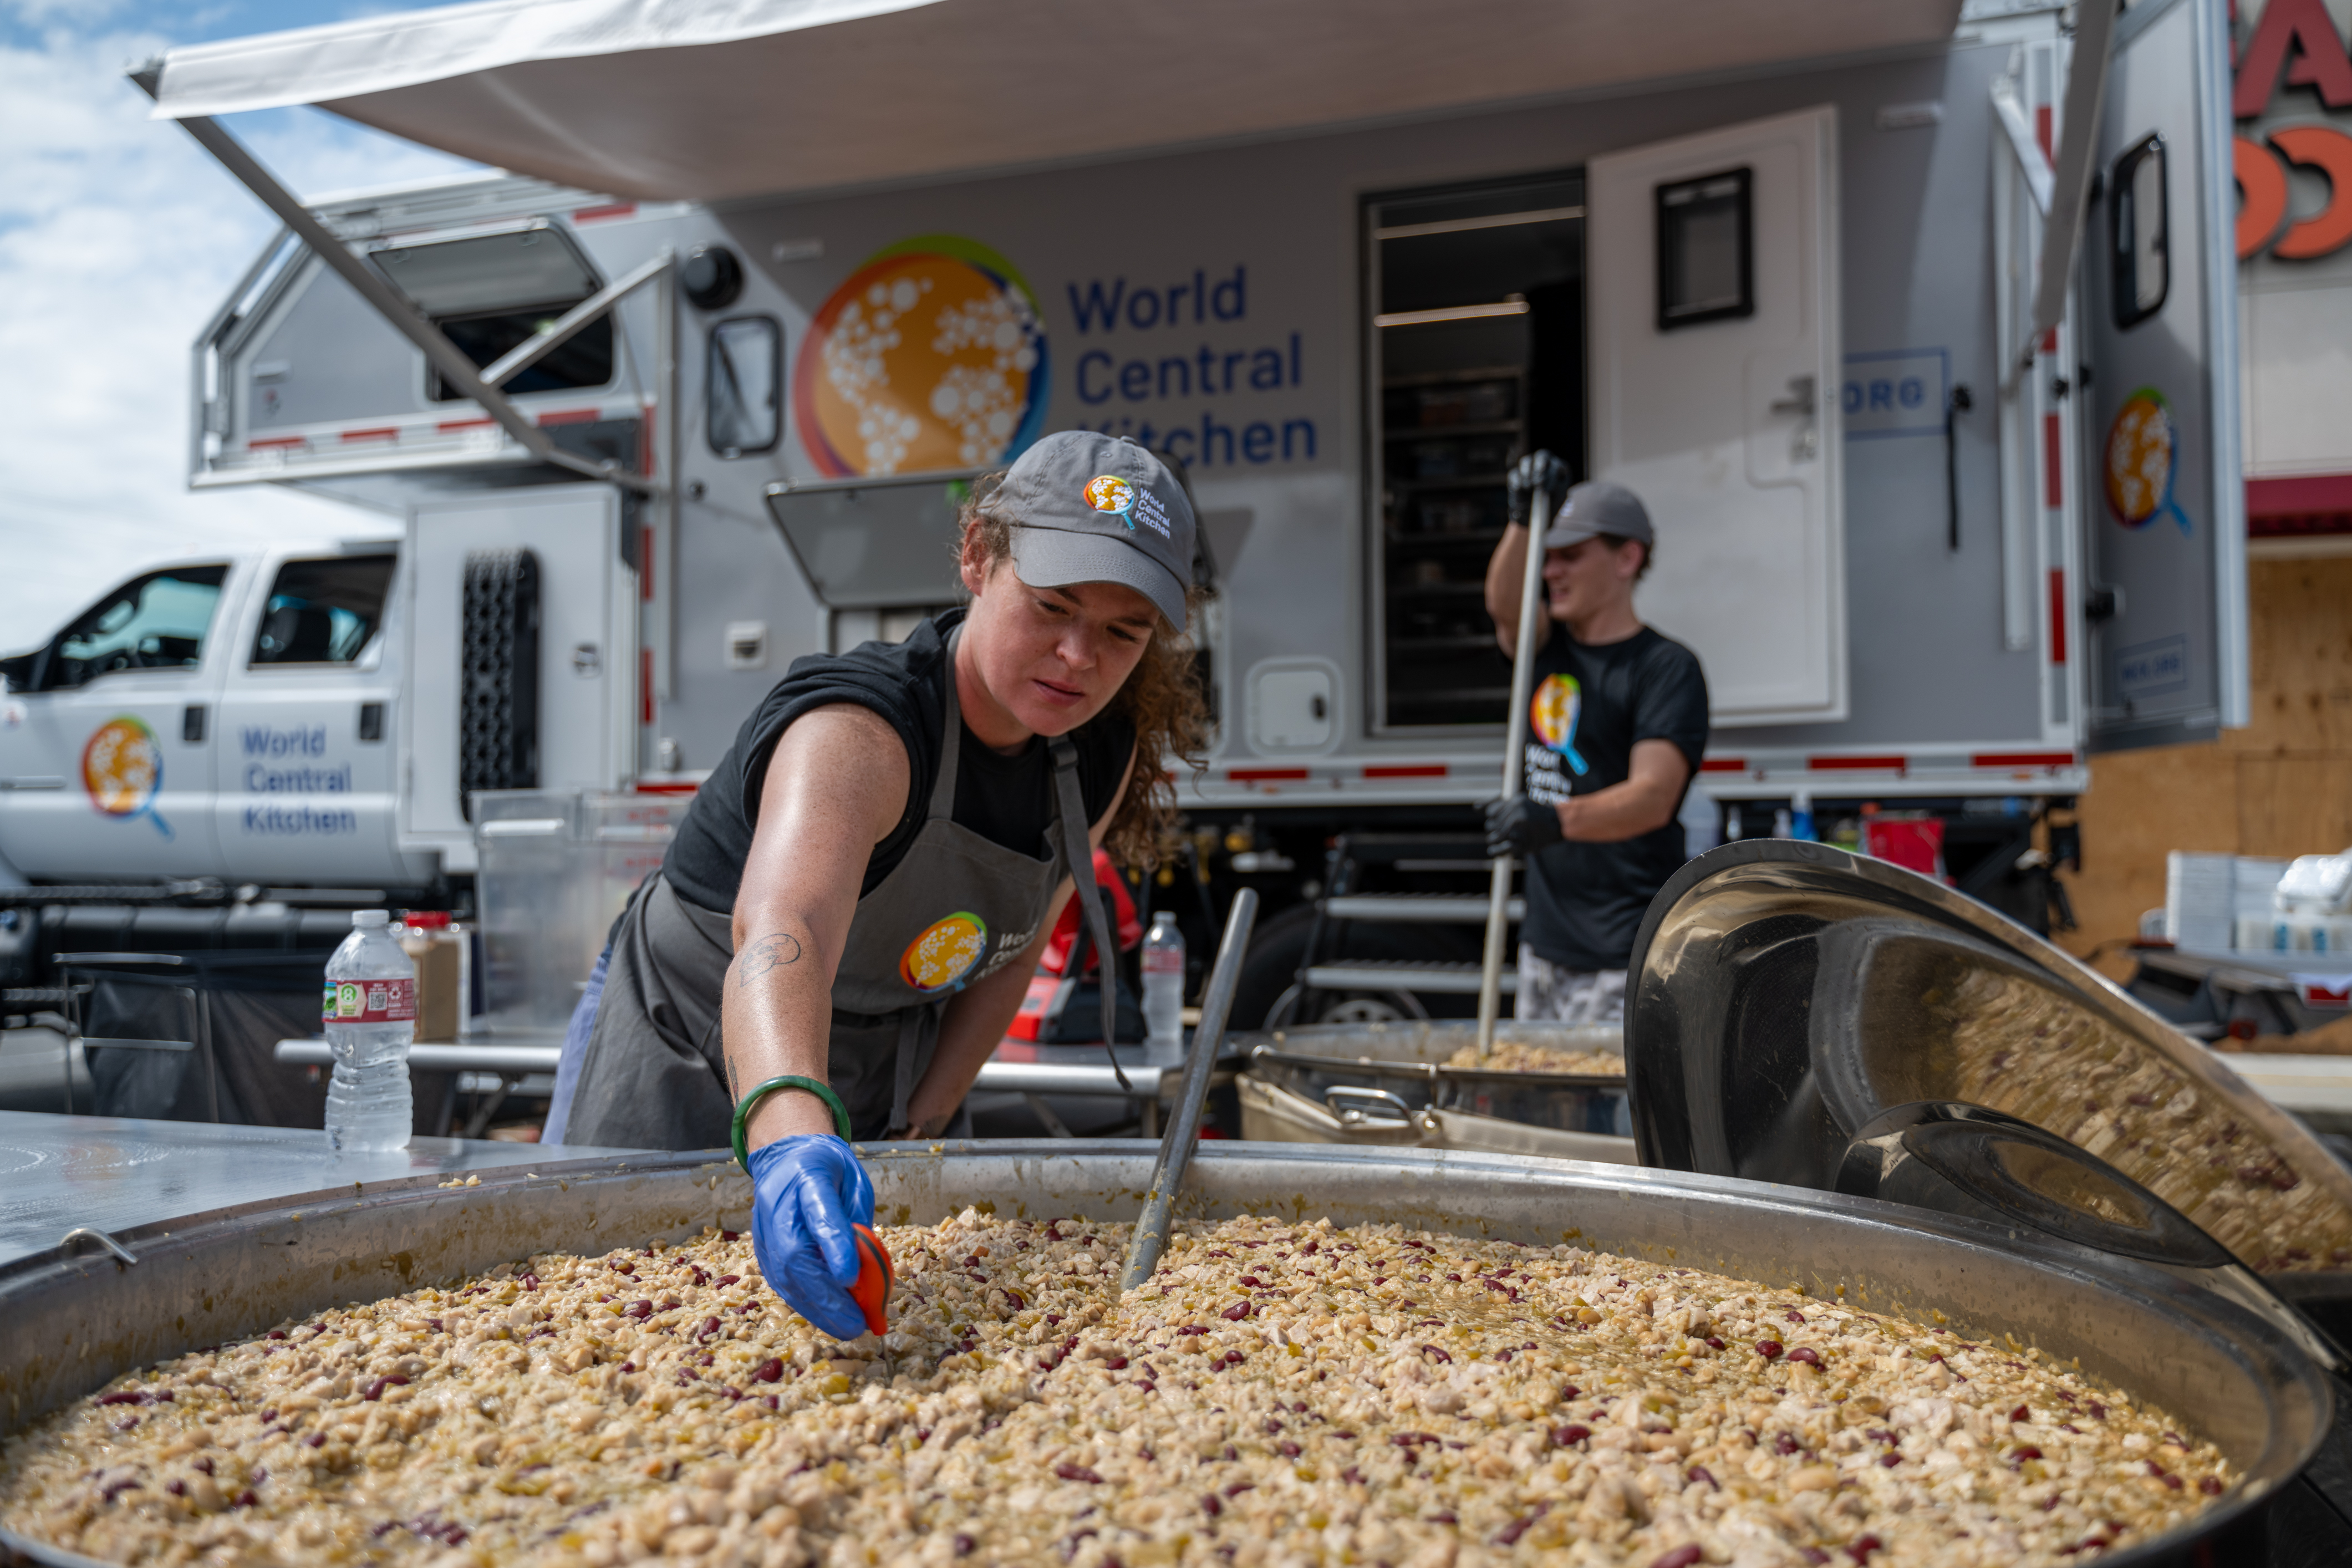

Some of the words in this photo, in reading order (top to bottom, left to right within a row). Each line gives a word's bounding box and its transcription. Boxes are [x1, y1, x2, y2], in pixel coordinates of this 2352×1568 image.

[1067, 265, 1247, 334] World
[1075, 332, 1303, 405] Central
[1138, 499, 1170, 527] Central
[1140, 487, 1165, 513] World
[1134, 510, 1170, 539] Kitchen
[243, 724, 327, 758] World
[243, 761, 352, 793] Central
[244, 803, 357, 834] Kitchen
